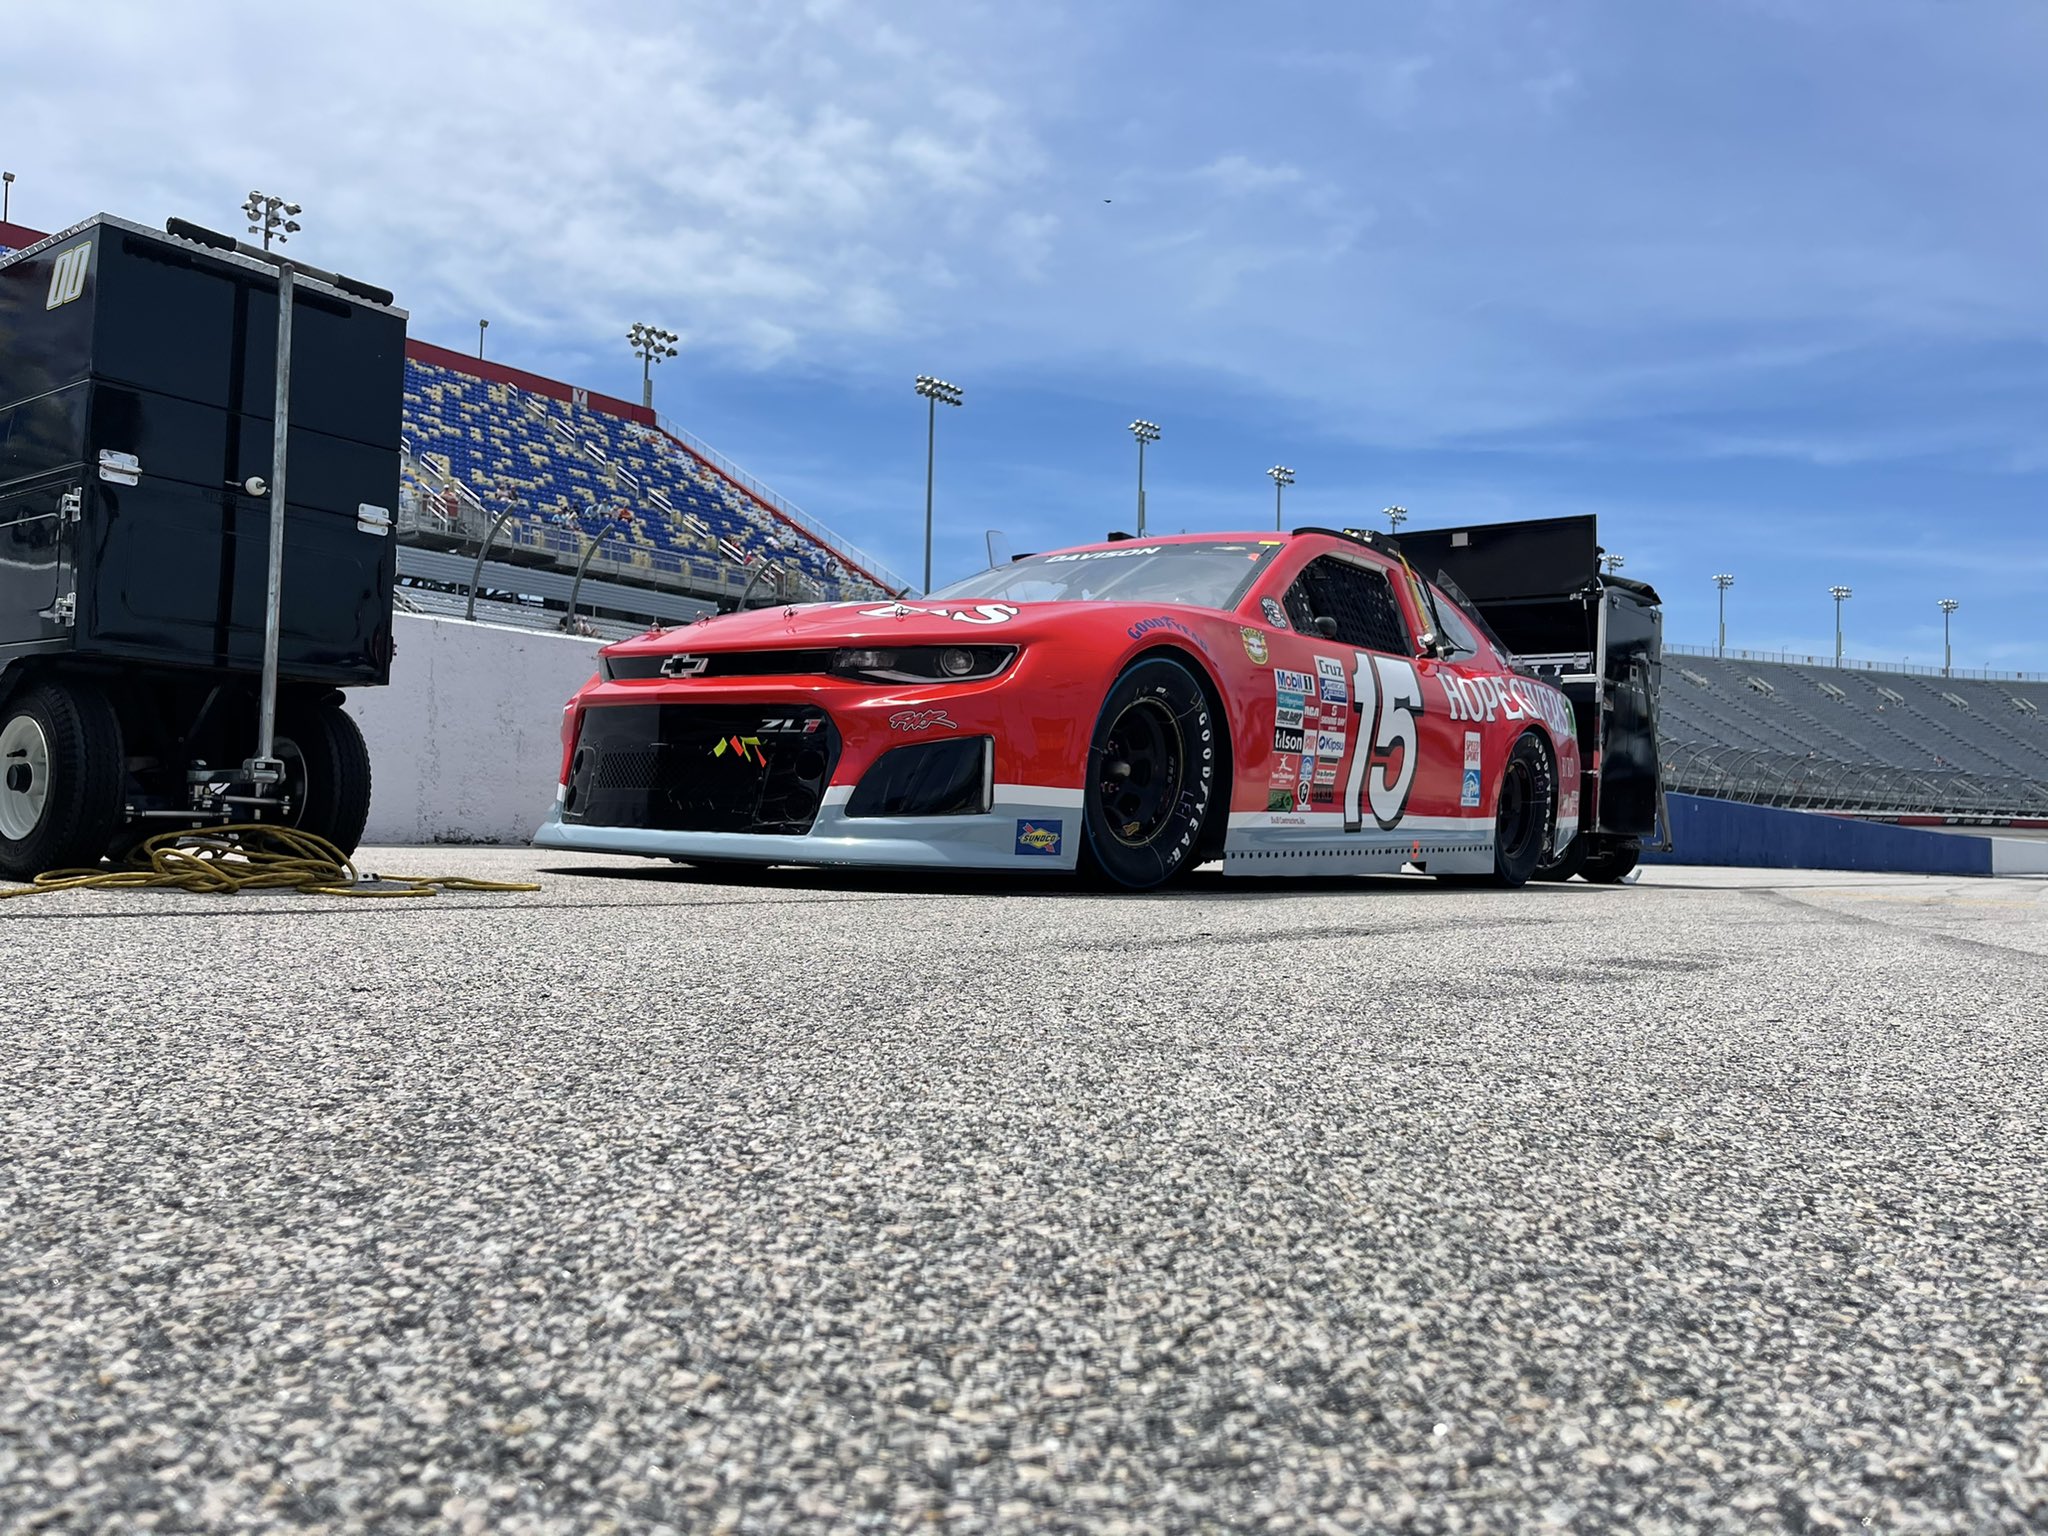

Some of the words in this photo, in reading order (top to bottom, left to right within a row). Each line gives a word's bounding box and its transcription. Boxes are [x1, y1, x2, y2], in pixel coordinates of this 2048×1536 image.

[46, 241, 92, 311] 00
[1045, 546, 1162, 564] DAVISON
[1127, 616, 1209, 653] GOODYEAR
[1319, 660, 1344, 677] Cruz
[1276, 670, 1303, 689] Mobil
[1303, 675, 1313, 691] 1
[756, 719, 822, 733] ZL1
[1275, 729, 1303, 751] tilson
[1325, 738, 1344, 752] Kipsu
[1343, 650, 1424, 832] 15
[1466, 740, 1480, 751] SPEED
[1465, 751, 1479, 761] SPORT
[1171, 712, 1212, 861] GOODYEAR
[1023, 834, 1057, 842] SUNOCO
